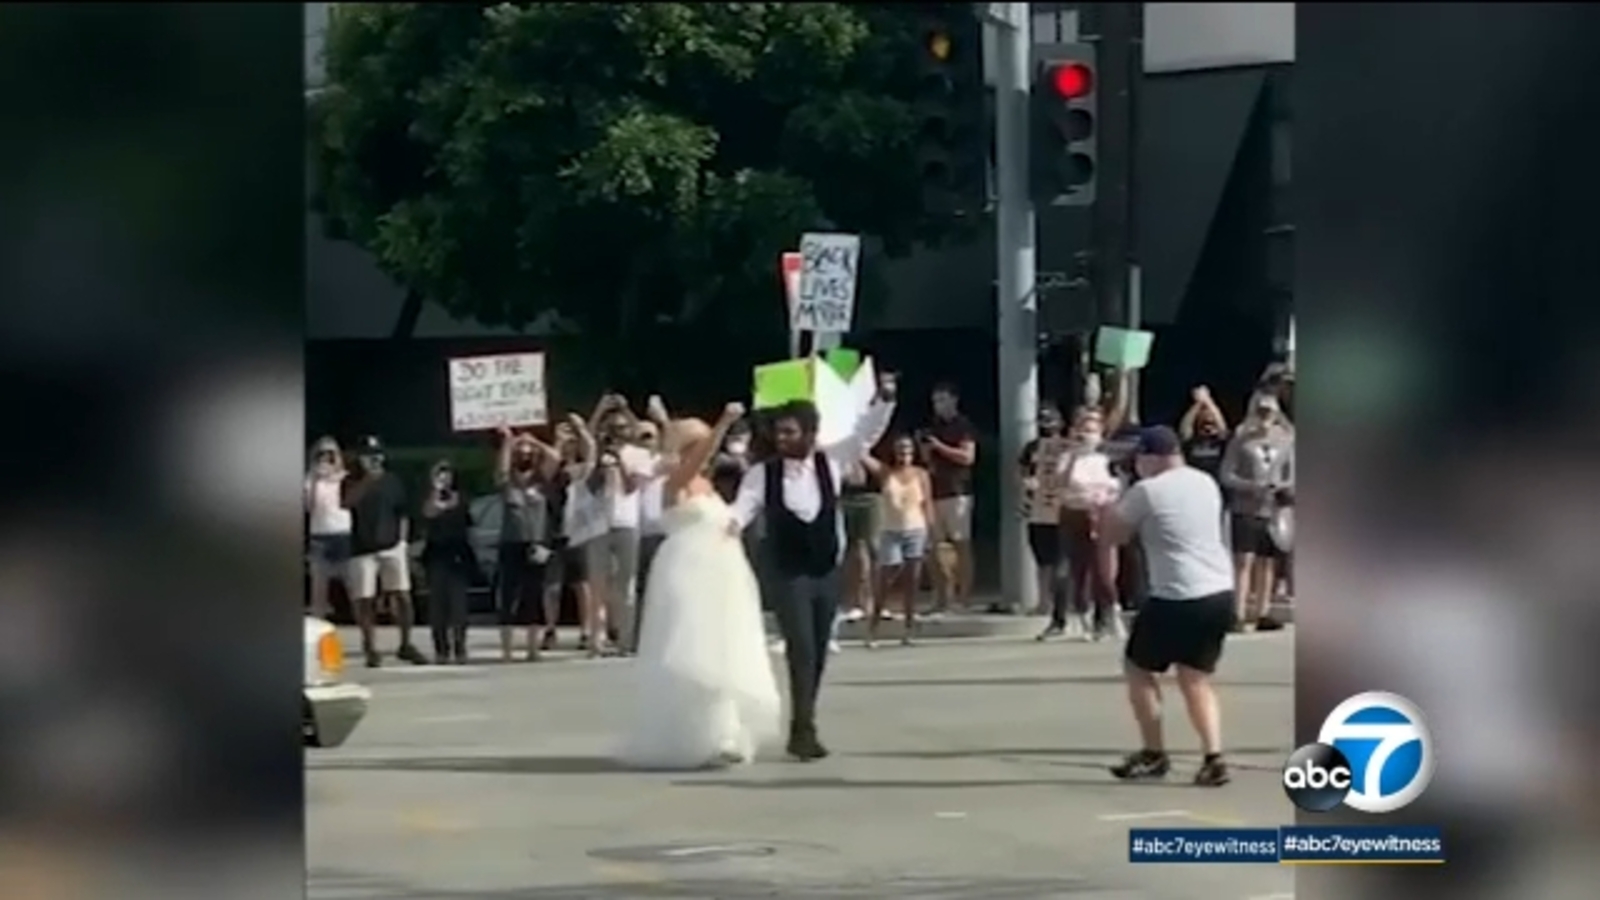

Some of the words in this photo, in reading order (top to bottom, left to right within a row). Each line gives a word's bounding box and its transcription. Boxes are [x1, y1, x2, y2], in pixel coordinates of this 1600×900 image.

[801, 241, 854, 275] BLACK
[800, 278, 850, 300] LIVES
[457, 361, 486, 382] DO
[494, 359, 524, 377] THE
